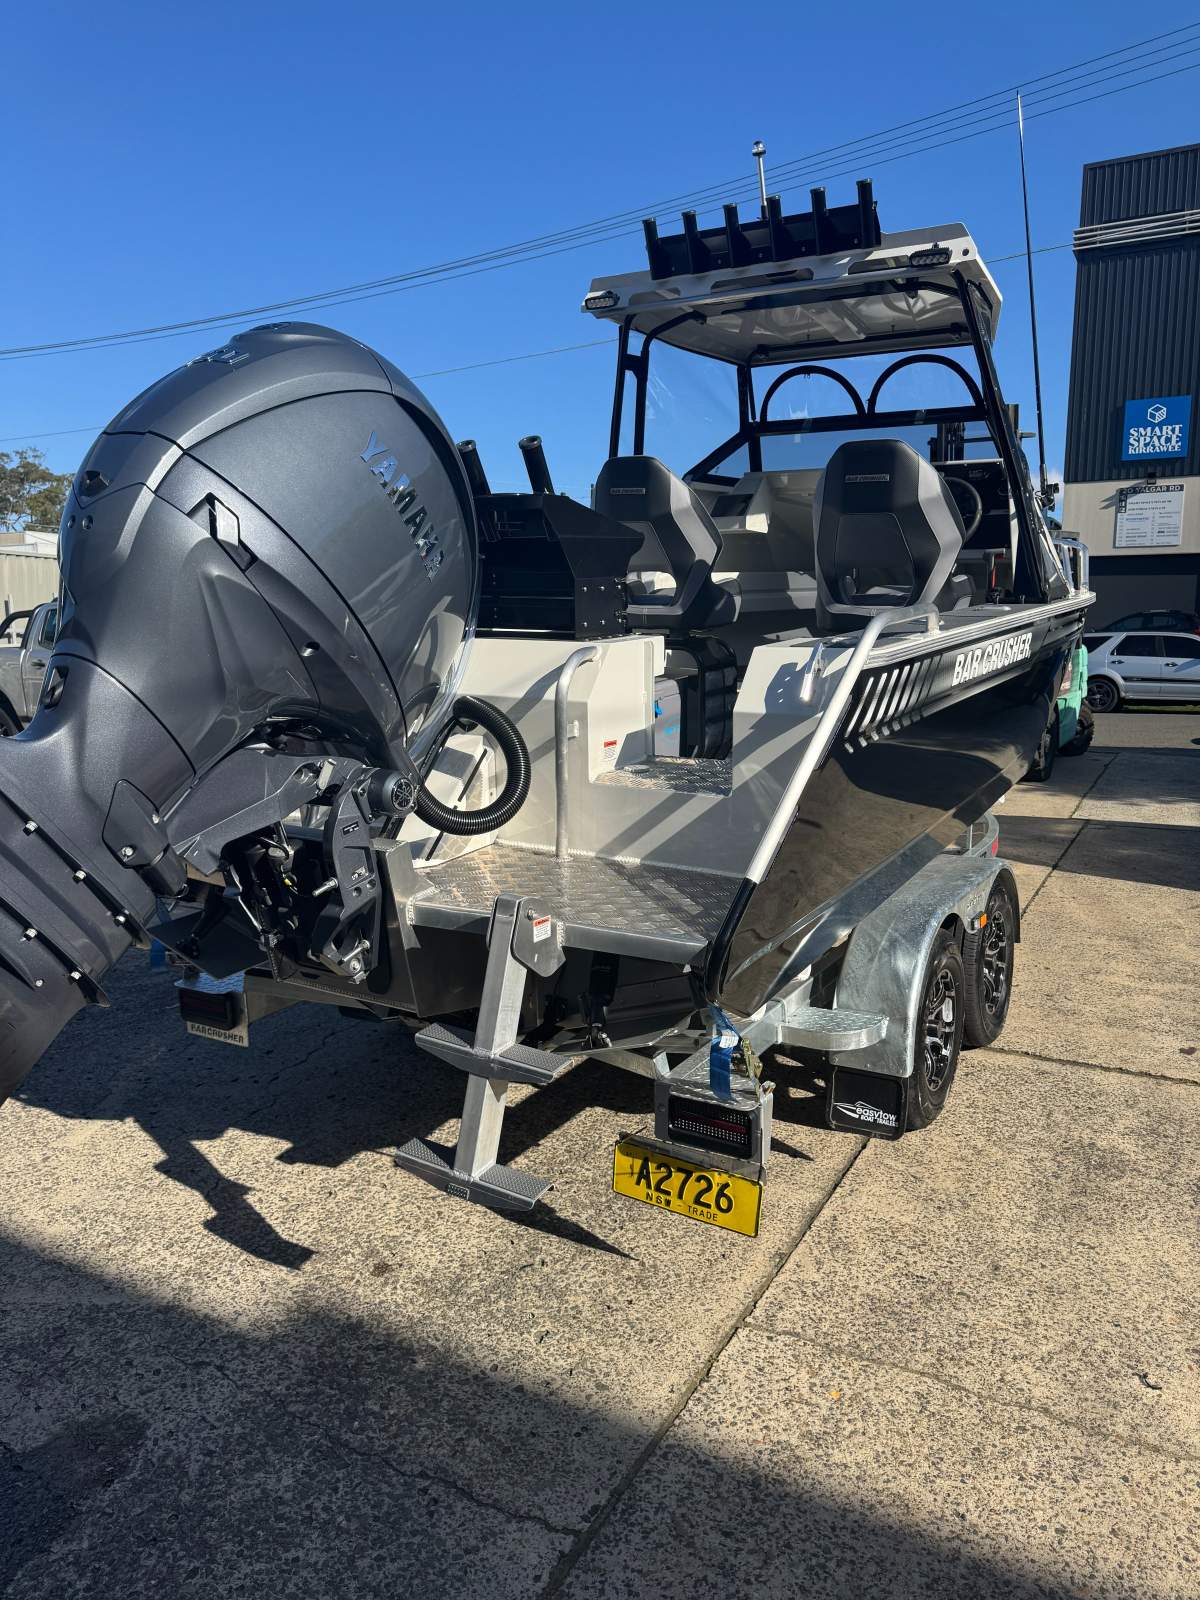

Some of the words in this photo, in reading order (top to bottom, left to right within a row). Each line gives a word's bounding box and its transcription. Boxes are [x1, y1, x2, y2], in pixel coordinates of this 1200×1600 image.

[1129, 424, 1183, 437] SMART
[1129, 434, 1182, 448] SPACE
[1128, 444, 1181, 454] KIRRAWEE
[360, 431, 445, 584] YAMAHA
[952, 648, 982, 687] BAR
[982, 632, 1032, 675] CRUSHER
[856, 1107, 897, 1121] easytow
[860, 1114, 874, 1122] BOAT
[635, 1156, 734, 1214] A2726
[645, 1191, 673, 1208] NSW
[687, 1204, 718, 1222] TRADE
